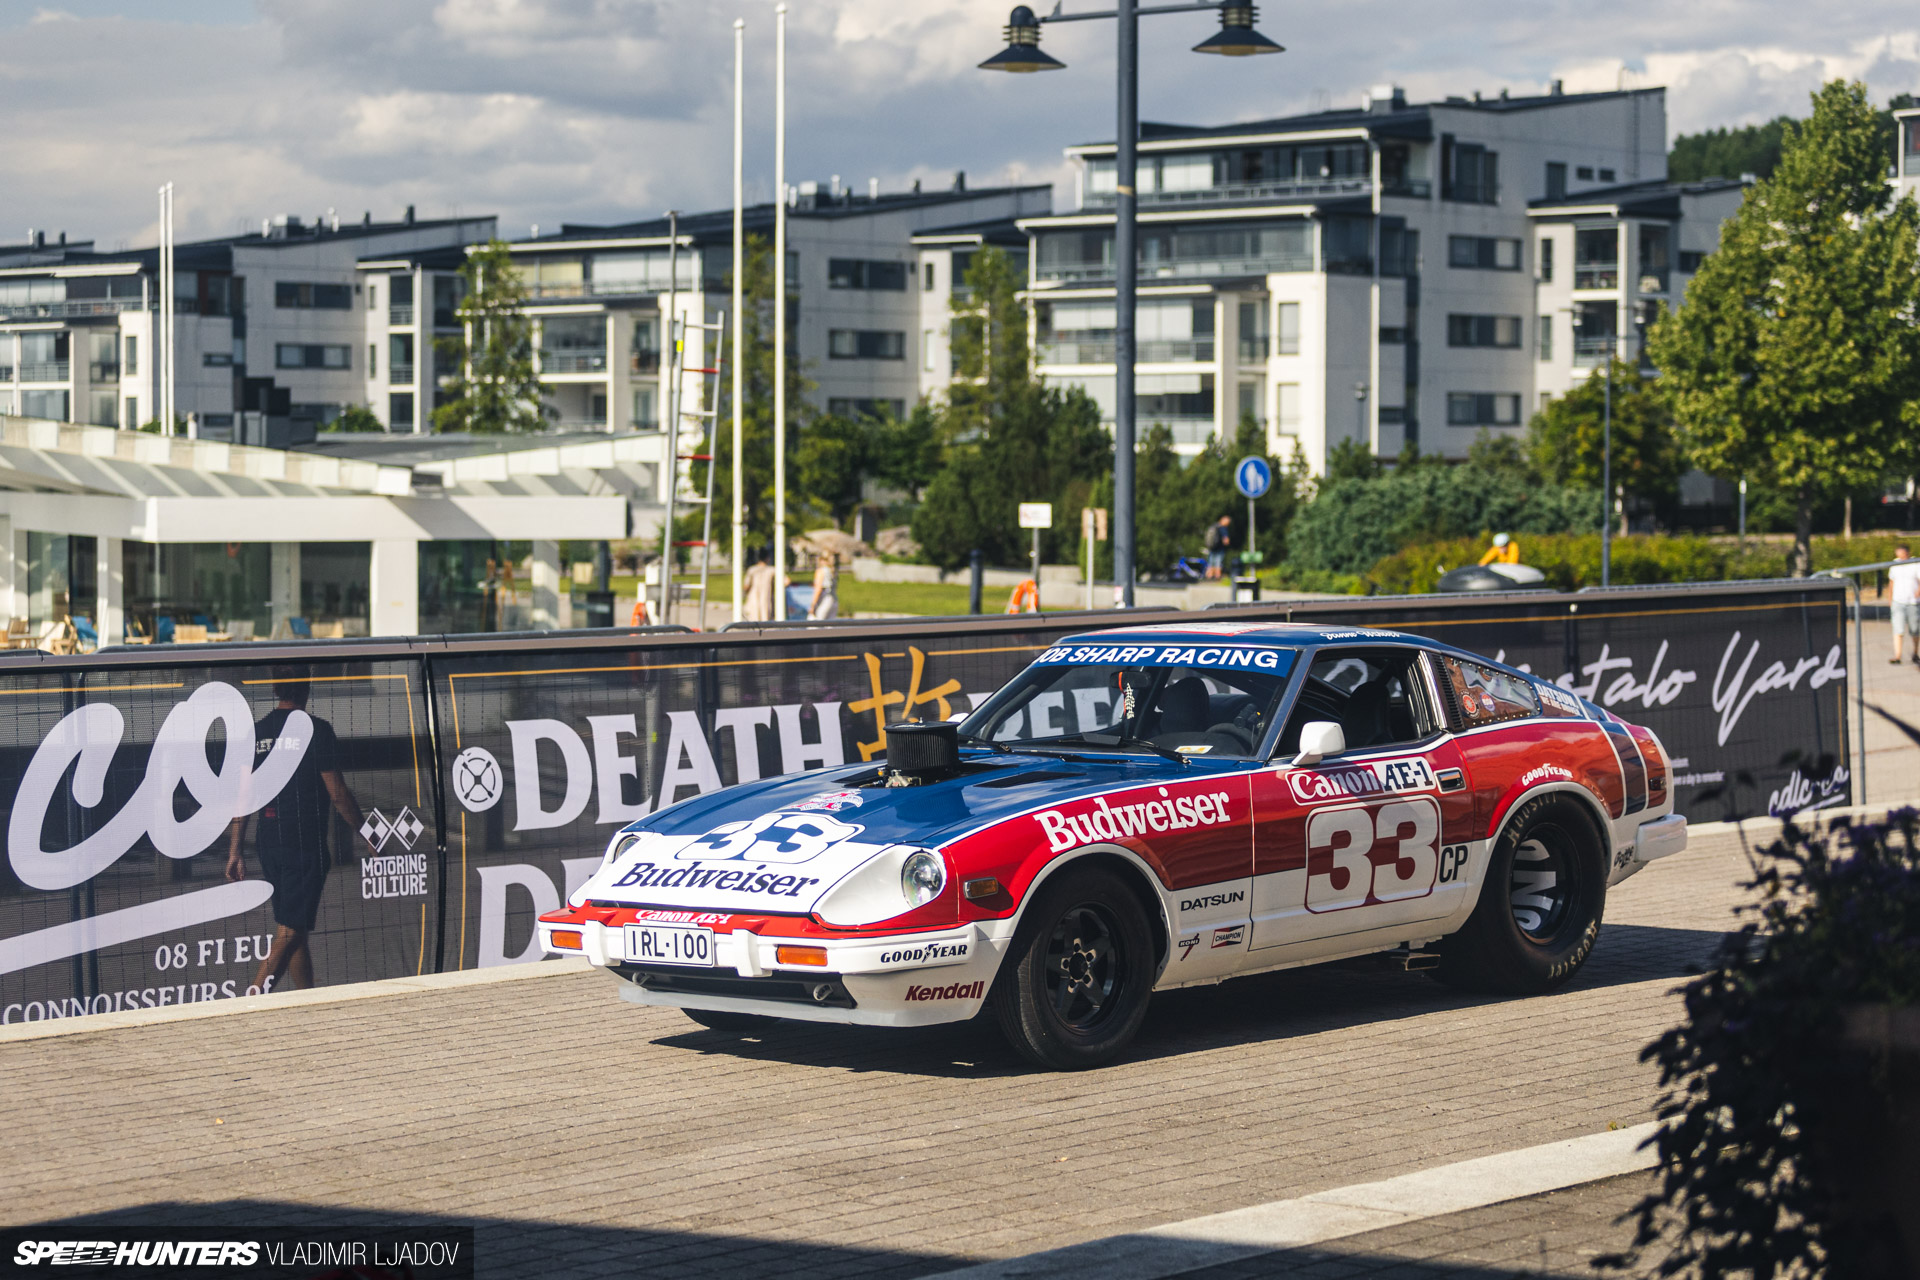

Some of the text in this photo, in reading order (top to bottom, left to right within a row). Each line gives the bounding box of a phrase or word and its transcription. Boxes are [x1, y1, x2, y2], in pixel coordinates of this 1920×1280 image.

[1067, 646, 1156, 663] SHARP
[1155, 647, 1279, 669] RACING
[505, 701, 845, 831] DEATH
[1291, 760, 1434, 800] Canon AE-1
[1522, 763, 1574, 786] GOODYEAR
[1033, 786, 1231, 853] Budweiser
[675, 812, 860, 864] 33
[361, 853, 427, 878] MOTORING
[1306, 799, 1439, 912] 33
[1439, 845, 1469, 884] CP
[362, 873, 428, 899] CULTURE
[611, 861, 820, 897] Budweiser
[1181, 891, 1245, 911] DATSUN
[635, 909, 736, 924] Canon AE-1
[632, 930, 708, 960] IRL-100
[1179, 938, 1199, 947] KONI
[1215, 931, 1242, 942] CHAMPION
[155, 934, 273, 971] 08 FI EU
[880, 943, 968, 964] GOODYEAR
[2, 974, 275, 1026] CONNOISSEURS of
[904, 980, 985, 1001] Kendall
